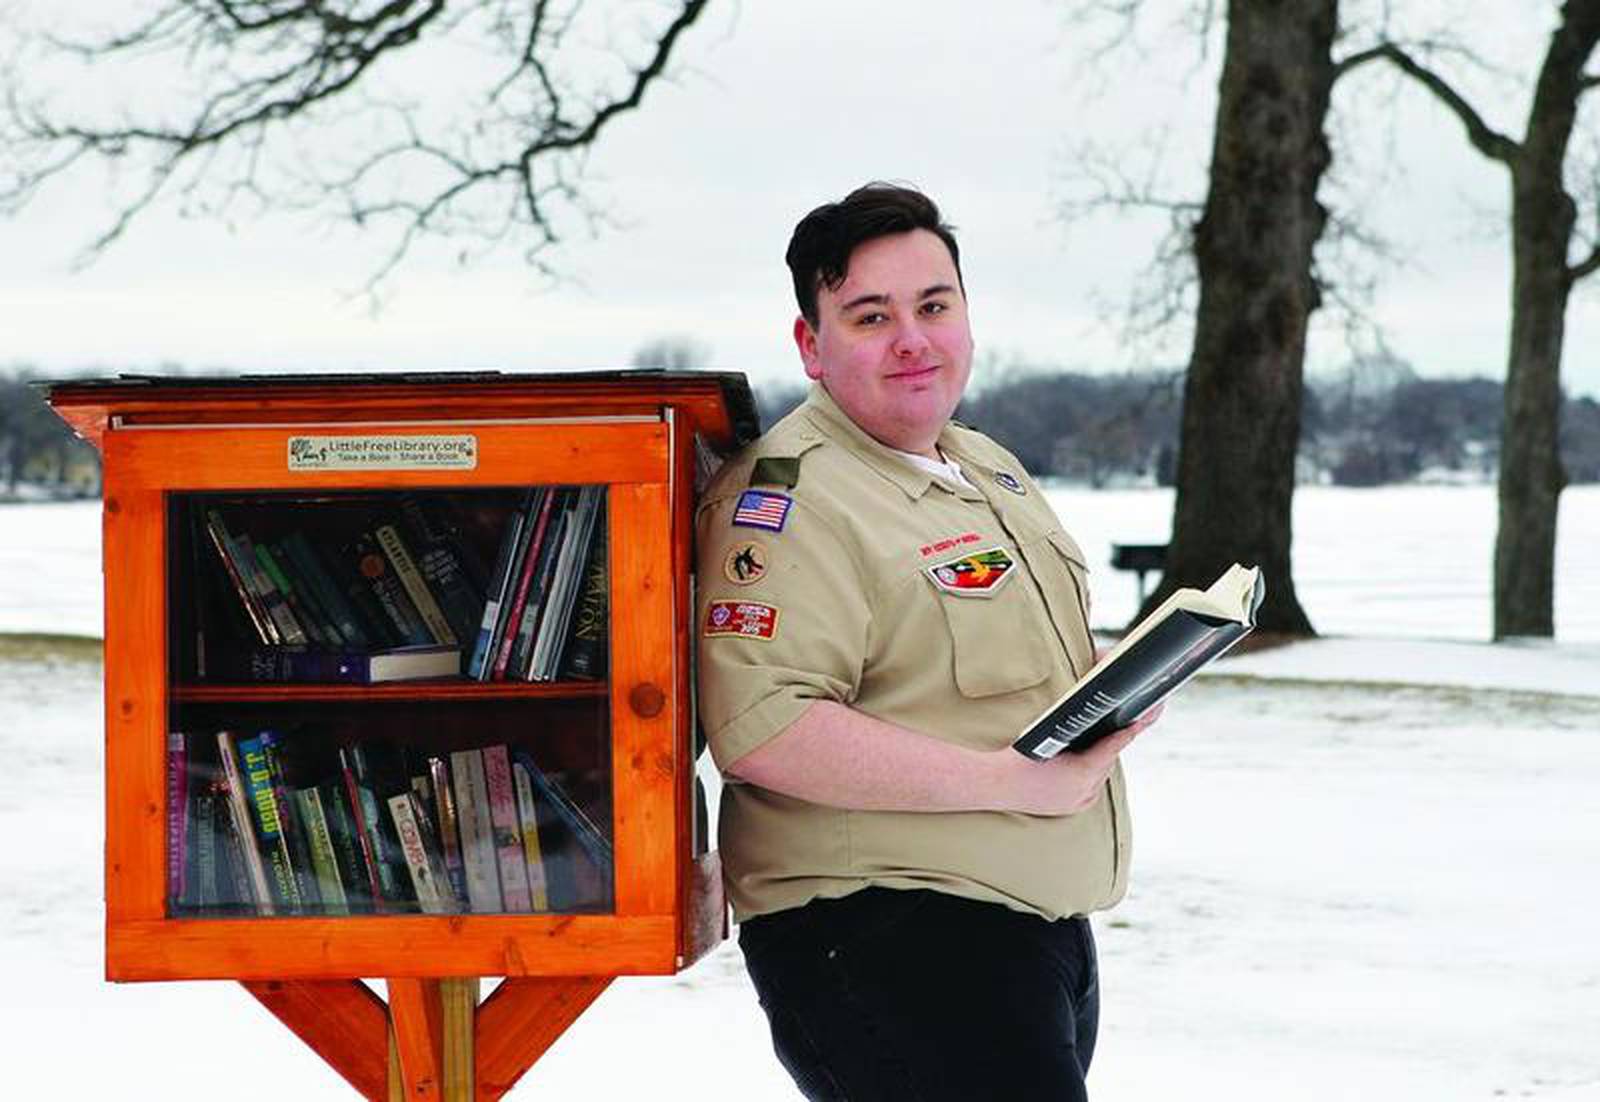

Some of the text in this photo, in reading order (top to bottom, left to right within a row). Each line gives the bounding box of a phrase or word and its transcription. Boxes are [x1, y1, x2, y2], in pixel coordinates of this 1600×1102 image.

[329, 440, 467, 453] LittleFreeLibrary.org
[336, 452, 359, 461] Take
[368, 452, 390, 461] Book
[400, 452, 427, 461] Share
[435, 452, 458, 461] Book
